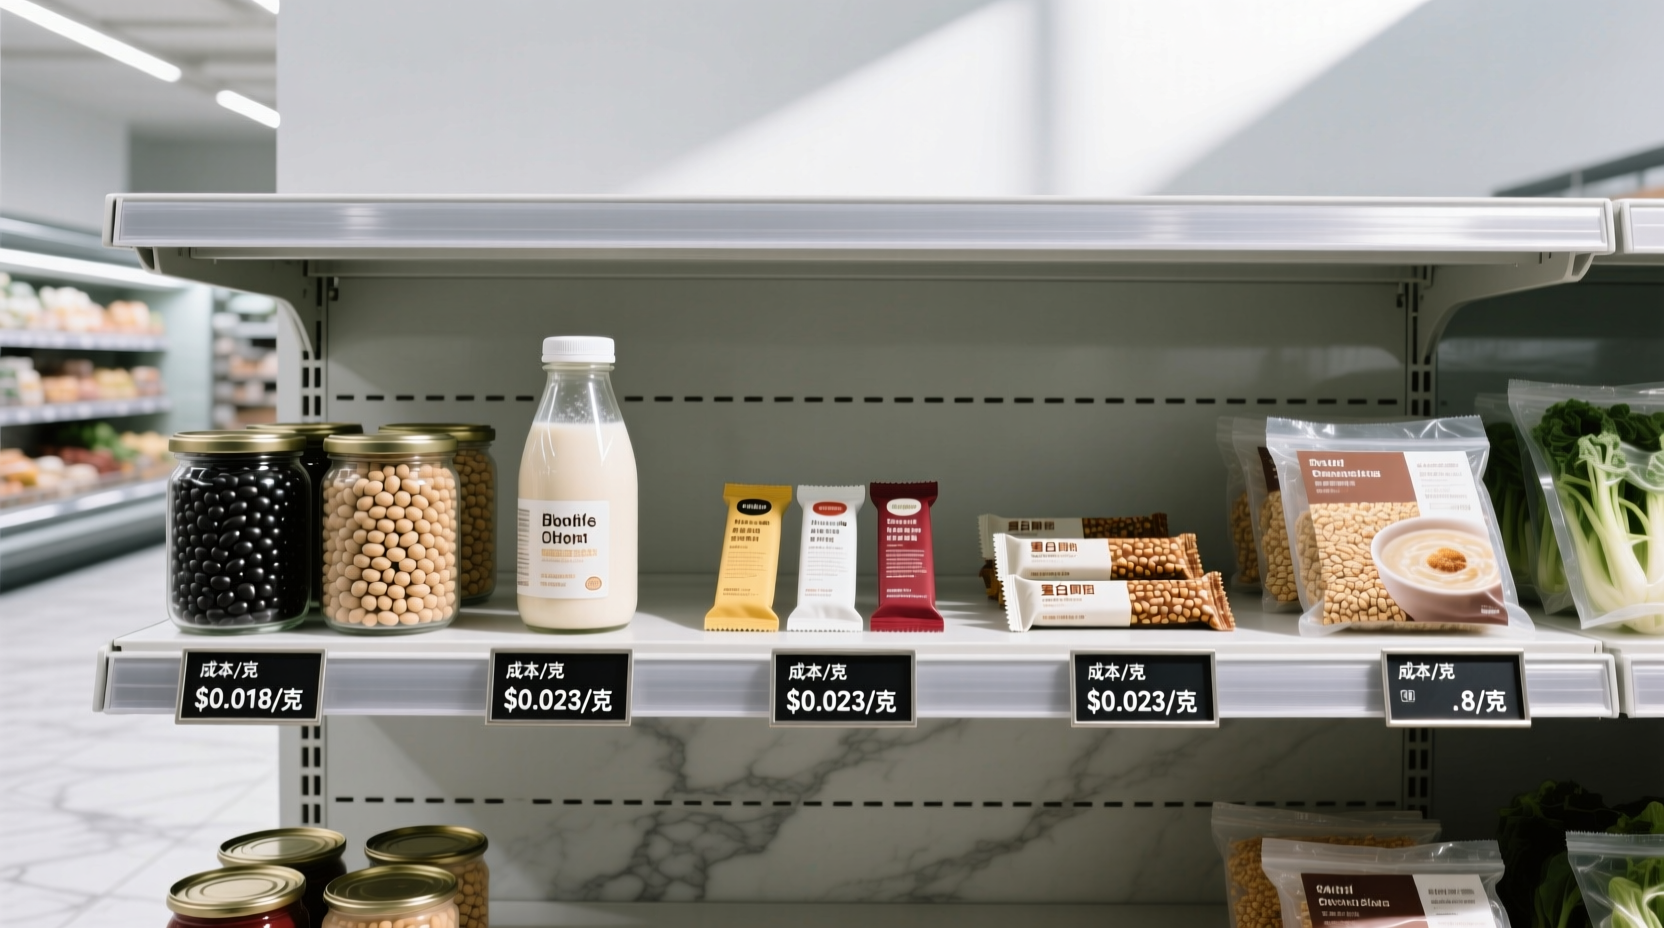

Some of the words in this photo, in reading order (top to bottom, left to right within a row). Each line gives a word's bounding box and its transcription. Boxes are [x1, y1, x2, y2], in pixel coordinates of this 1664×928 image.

[199, 659, 259, 680] 成本/克
[505, 660, 565, 680] 成本/克
[788, 661, 848, 682] 成本/克
[1087, 661, 1147, 682] 成本/克
[1398, 661, 1456, 681] 成本/克
[194, 685, 304, 713] $0.018/克
[503, 685, 613, 714] $0.023/克
[786, 687, 897, 715] $0.023/克
[1087, 686, 1198, 716] $0.023/克
[1452, 689, 1507, 715] .8/克
